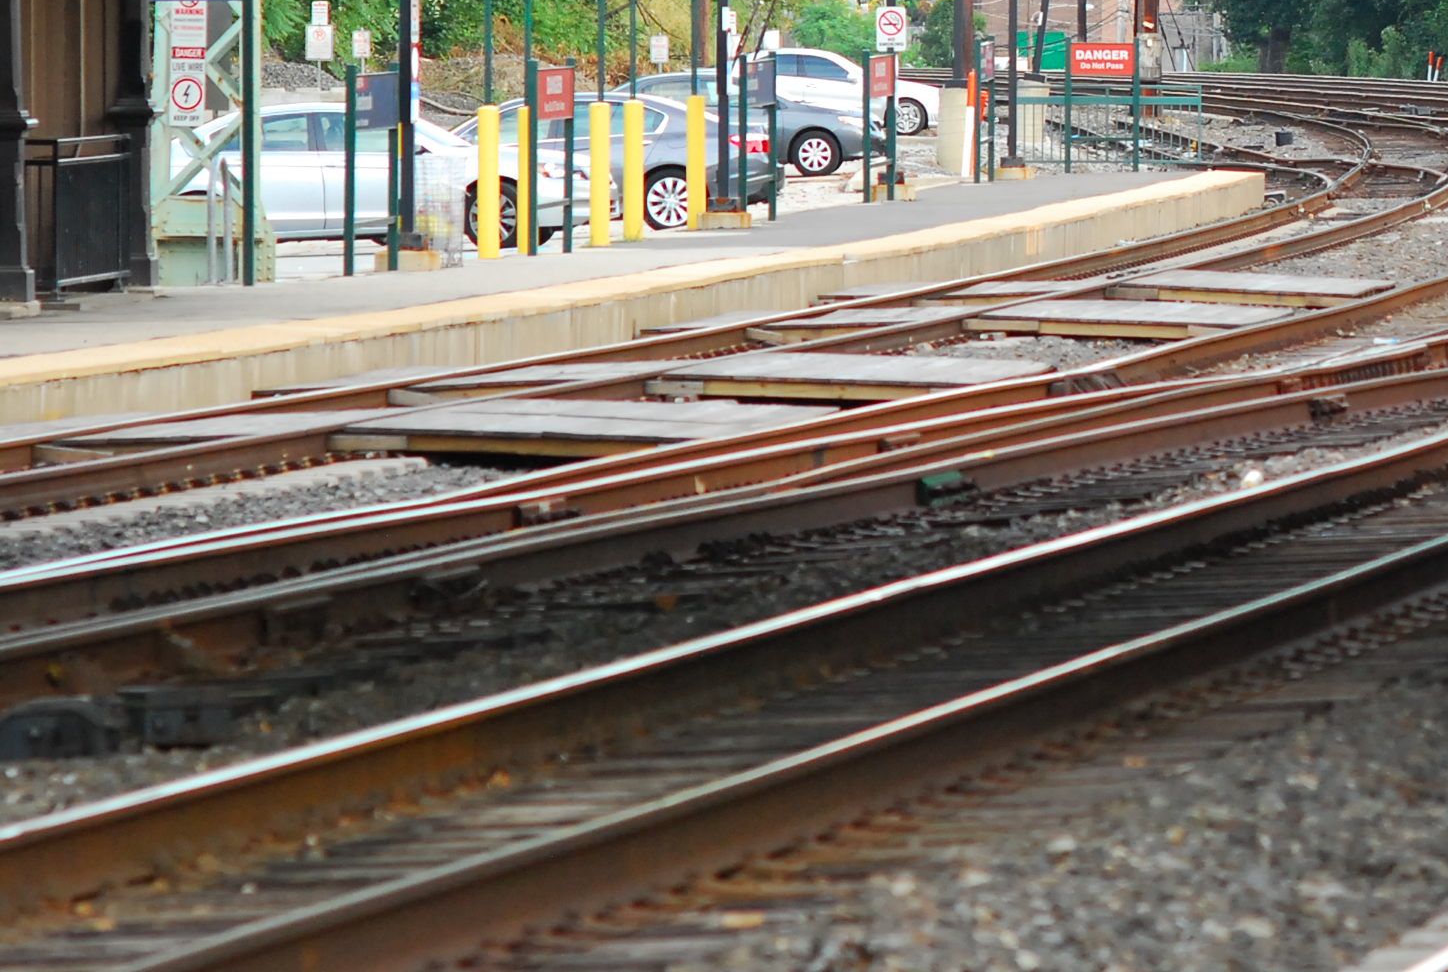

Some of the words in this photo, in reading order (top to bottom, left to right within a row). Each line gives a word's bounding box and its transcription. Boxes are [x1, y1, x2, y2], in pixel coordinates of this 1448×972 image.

[1075, 49, 1129, 60] DANGER
[172, 62, 186, 71] LIVE
[188, 62, 204, 71] WIRE
